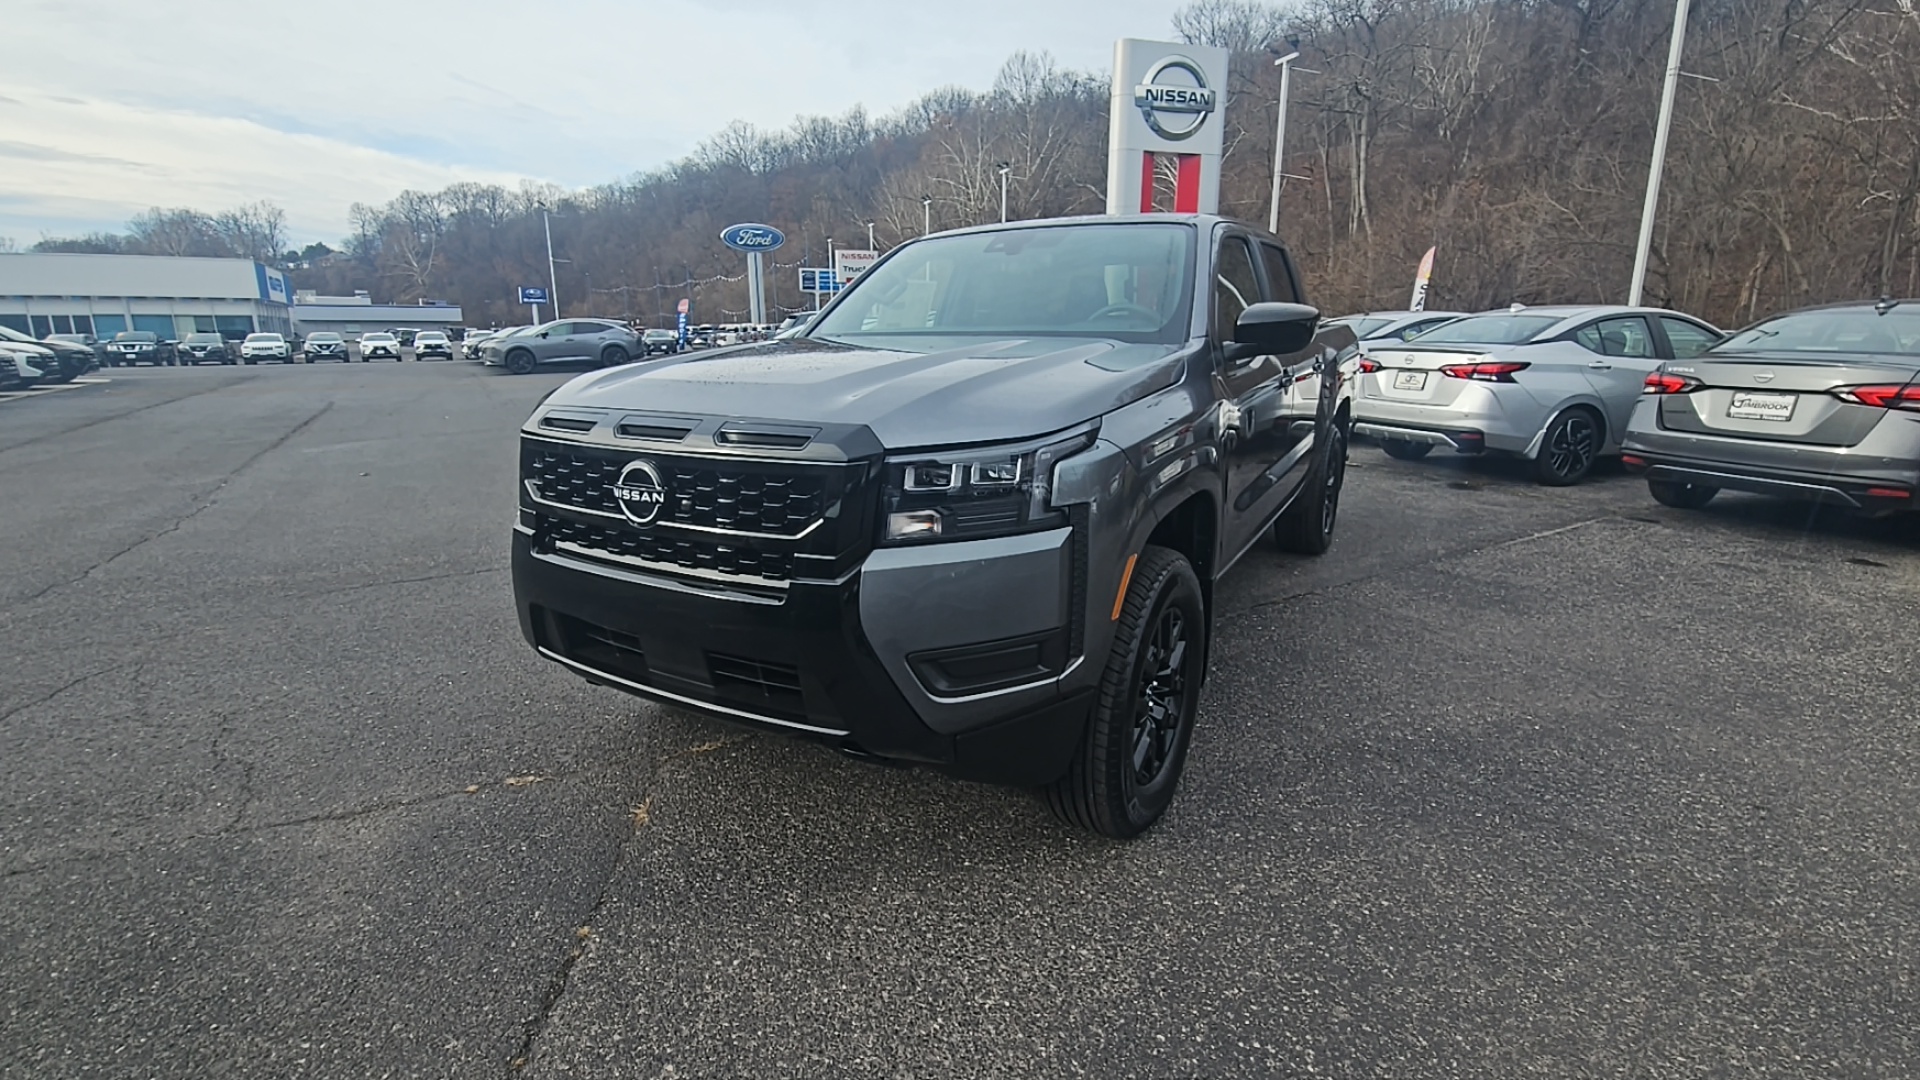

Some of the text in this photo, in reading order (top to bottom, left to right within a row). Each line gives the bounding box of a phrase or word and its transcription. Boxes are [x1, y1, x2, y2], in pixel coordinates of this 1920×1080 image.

[1145, 88, 1211, 106] NISSAN
[736, 229, 773, 246] Ford
[613, 487, 664, 503] NISSAN
